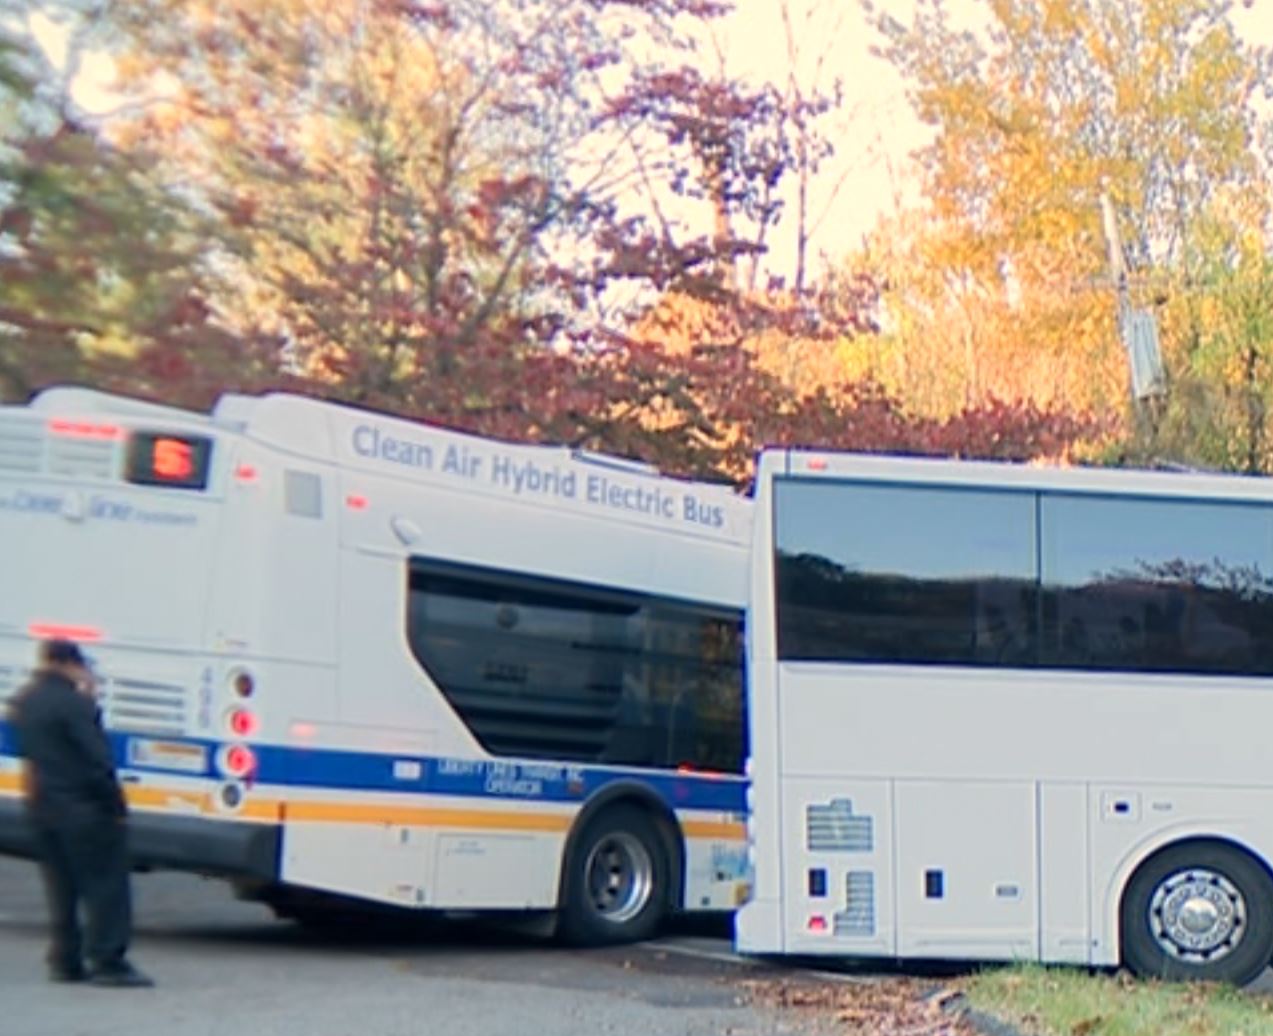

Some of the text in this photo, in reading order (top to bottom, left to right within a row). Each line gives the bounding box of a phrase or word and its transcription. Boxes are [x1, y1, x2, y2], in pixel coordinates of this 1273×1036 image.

[351, 424, 725, 529] Clean Air Hybrid Electric Bus
